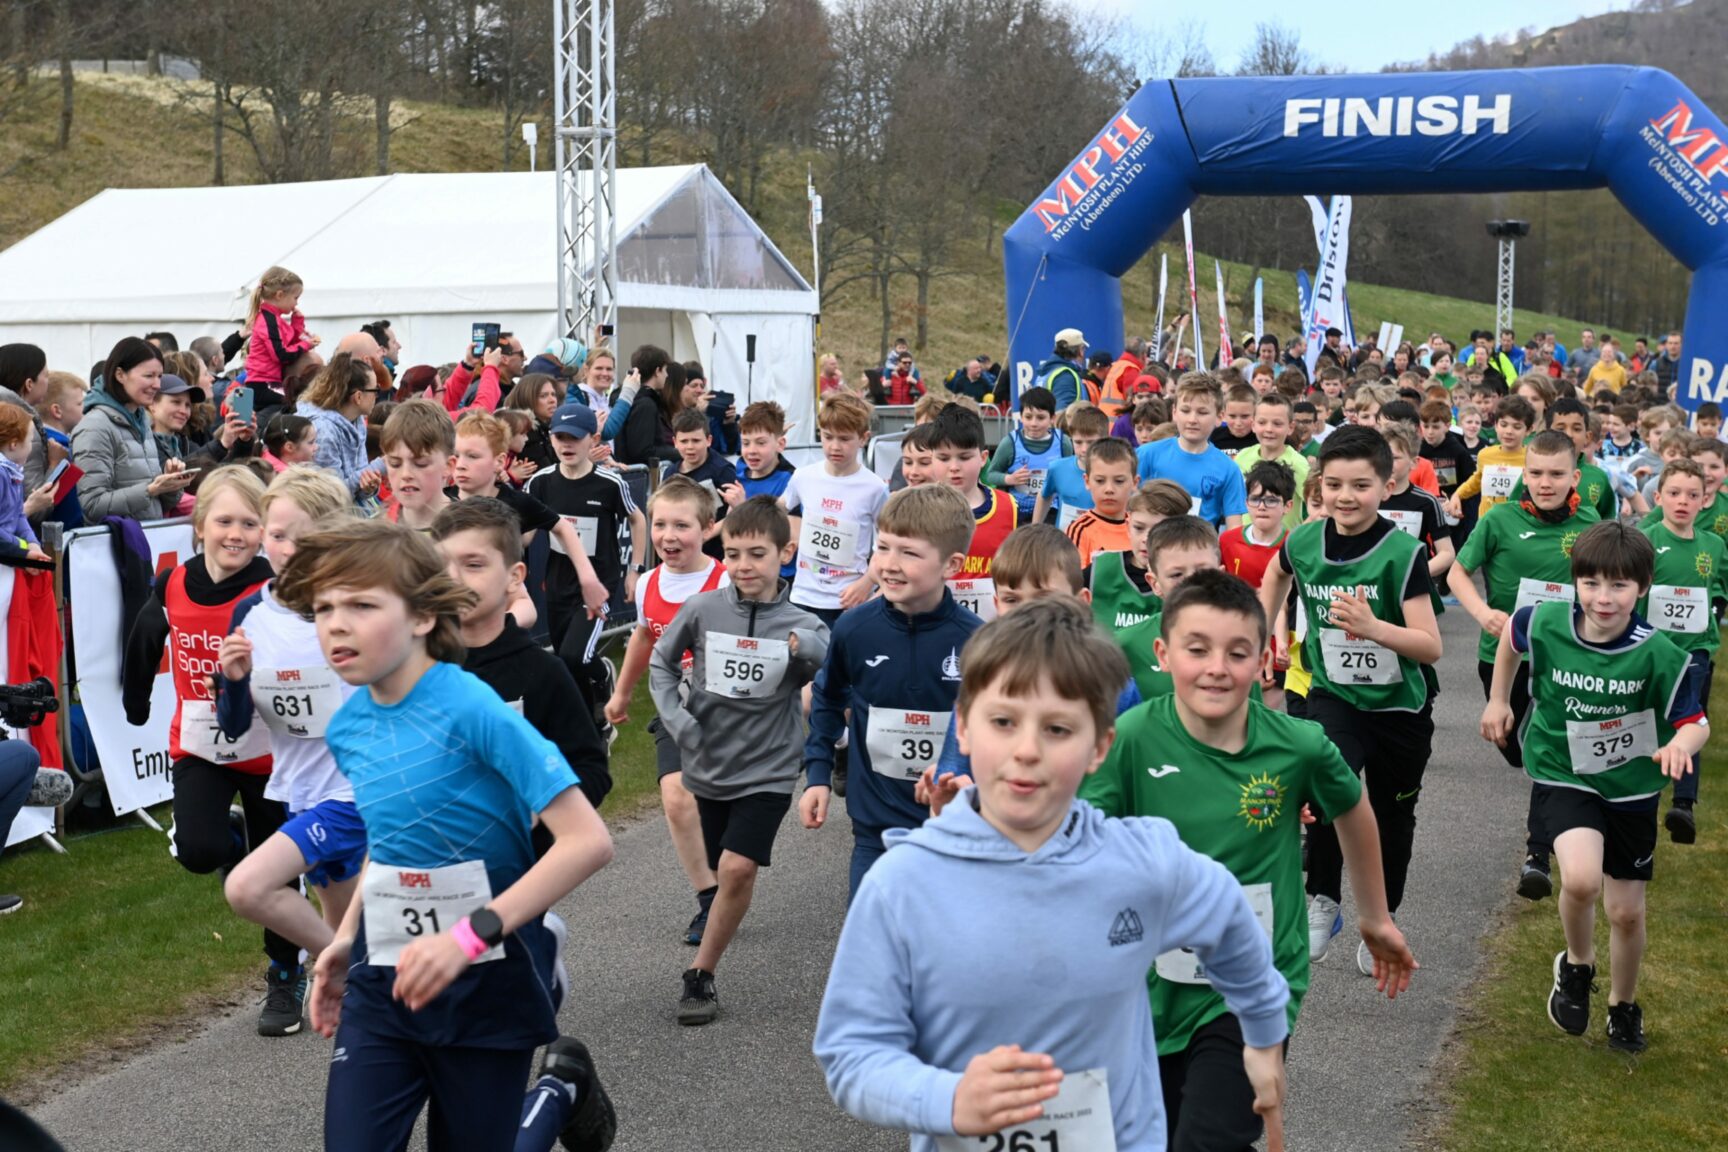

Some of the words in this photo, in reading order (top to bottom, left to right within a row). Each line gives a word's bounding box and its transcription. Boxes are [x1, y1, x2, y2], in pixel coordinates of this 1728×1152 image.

[1283, 94, 1511, 137] FINISH
[1649, 97, 1728, 204] MP
[1031, 108, 1147, 234] MPH
[1639, 125, 1693, 182] McINTOSH
[1689, 174, 1727, 214] PLANT
[1051, 190, 1102, 242] McINTOSH
[1098, 157, 1131, 192] PLANT
[1128, 131, 1155, 160] HIRE
[1080, 183, 1126, 231] (Aberdeen)
[1121, 162, 1147, 185] LTD.
[1648, 156, 1698, 207] (Aberdeen)
[1695, 202, 1719, 226] LTD
[1491, 478, 1510, 488] 249
[821, 498, 843, 510] MPH
[822, 516, 839, 527] MPH
[811, 530, 841, 550] 288
[962, 556, 985, 574] ARK
[955, 582, 974, 590] MPH
[1347, 584, 1379, 600] PRK
[1545, 583, 1562, 593] MPH
[1674, 588, 1690, 596] MPH
[1664, 603, 1695, 618] 327
[171, 624, 223, 651] Tarla
[736, 639, 759, 651] MPH
[178, 650, 223, 677] Spor
[723, 659, 764, 682] 596
[1340, 651, 1377, 668] 276
[276, 669, 301, 682] MPH
[1552, 667, 1604, 693] MANOR
[1608, 679, 1646, 695] PARK
[273, 694, 313, 717] 631
[1564, 696, 1628, 719] Runners
[905, 712, 930, 726] MPH
[1599, 719, 1622, 731] MPH
[901, 739, 934, 761] 39
[1593, 733, 1634, 757] 379
[133, 747, 173, 780] Emp
[398, 871, 432, 888] MPH
[402, 907, 440, 937] 31
